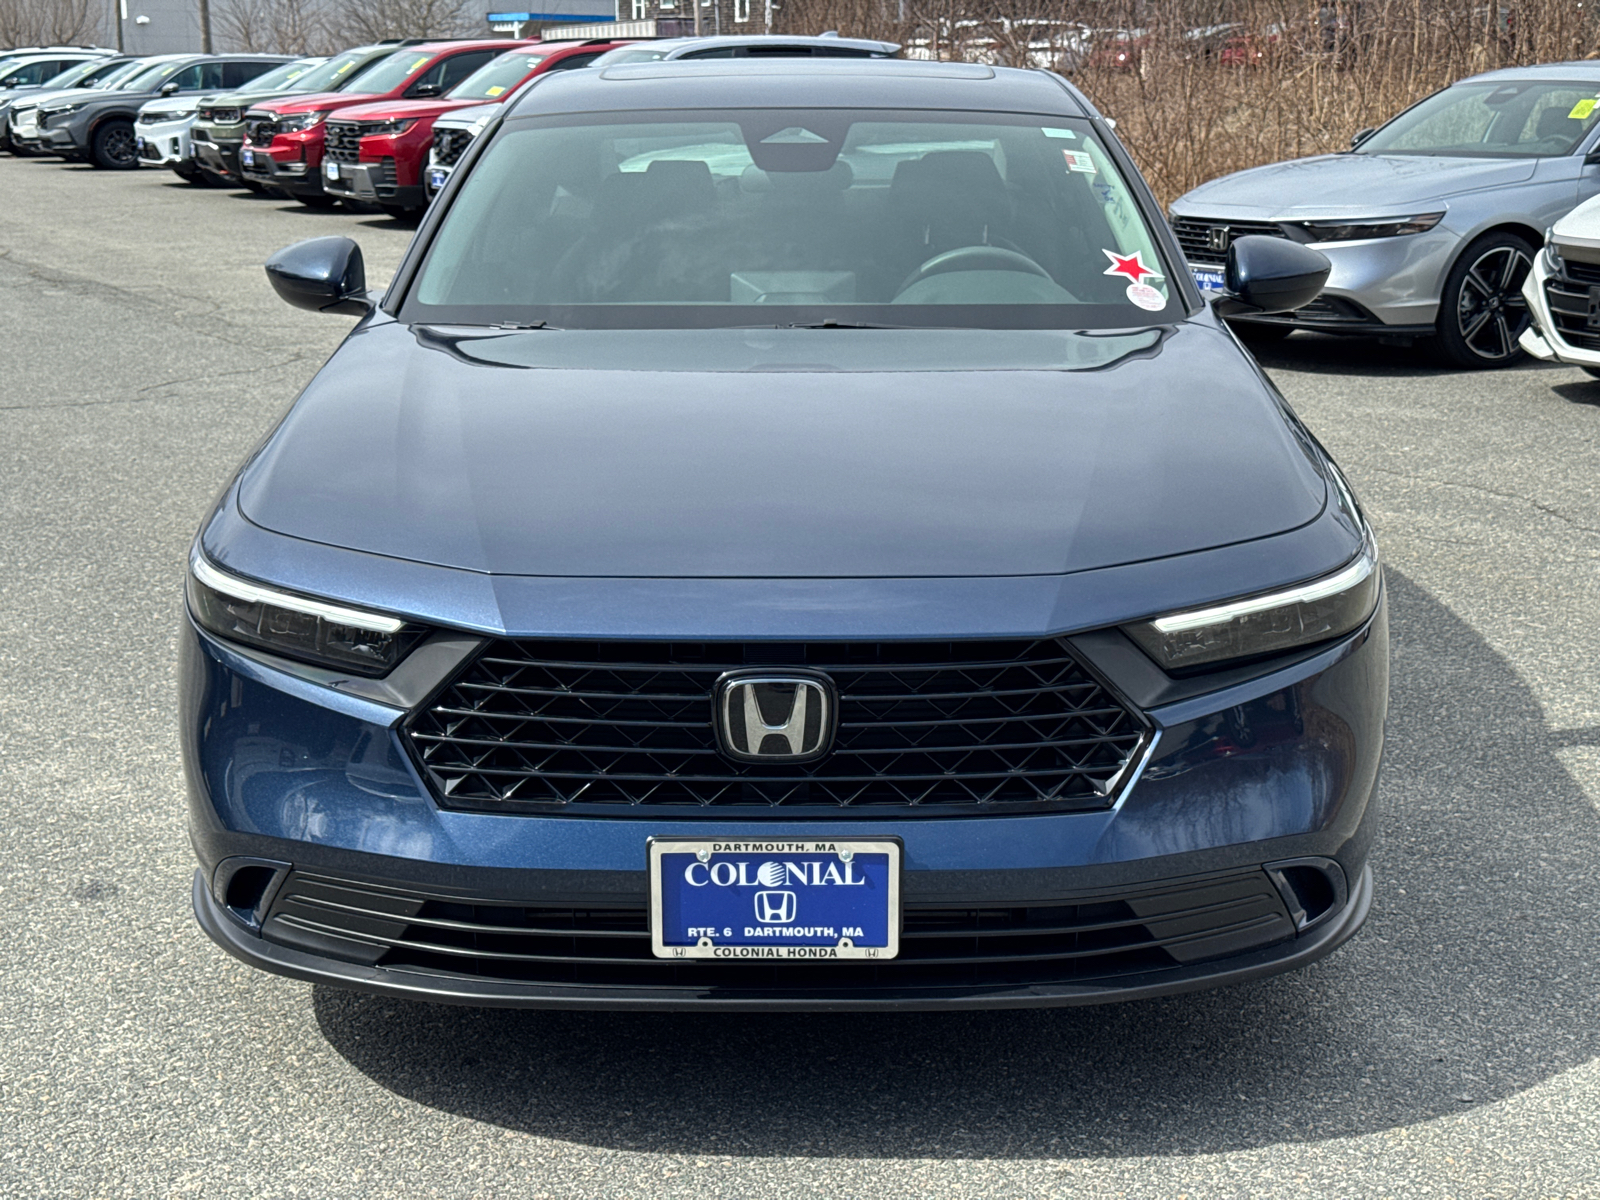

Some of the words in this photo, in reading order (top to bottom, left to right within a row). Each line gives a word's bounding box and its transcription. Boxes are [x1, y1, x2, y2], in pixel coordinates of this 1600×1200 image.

[713, 843, 809, 852] DARTMOUTH,
[815, 843, 837, 852] MA
[684, 861, 865, 887] COLONIAL
[687, 927, 719, 937] RTE.
[723, 927, 732, 937] 6
[744, 927, 838, 938] DARTMOUTH,
[842, 927, 864, 937] MA
[713, 947, 781, 957] COLONIAL
[787, 948, 838, 958] HONDA
